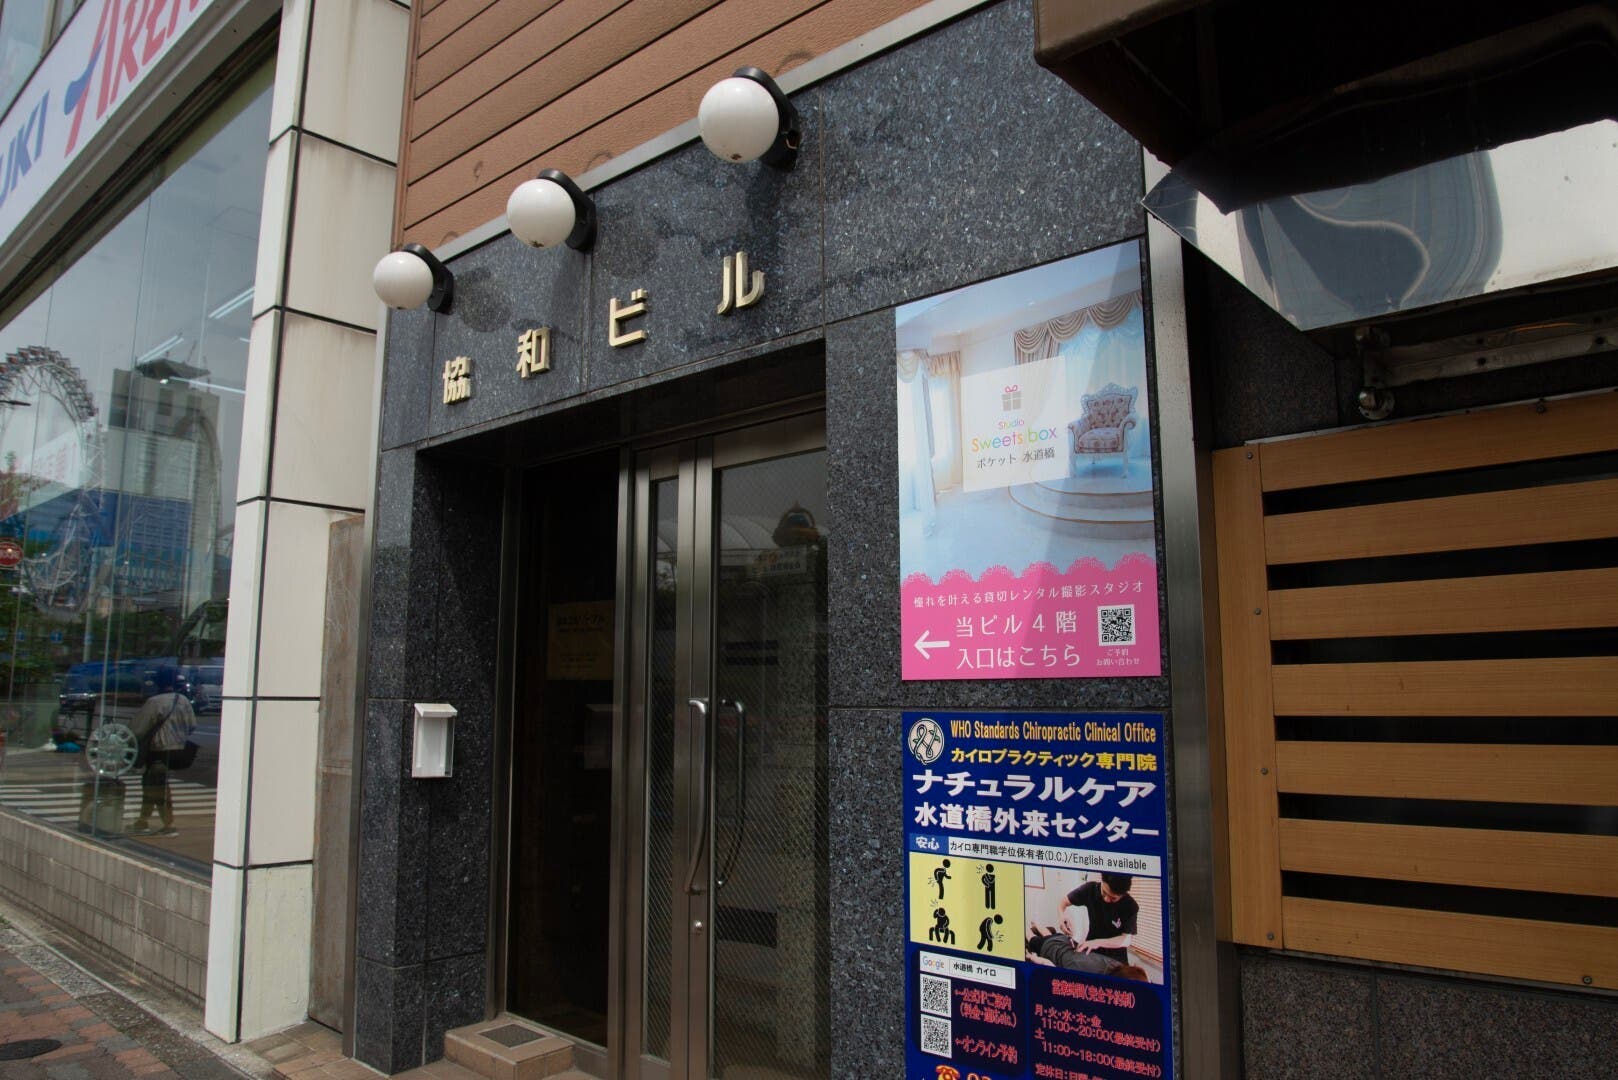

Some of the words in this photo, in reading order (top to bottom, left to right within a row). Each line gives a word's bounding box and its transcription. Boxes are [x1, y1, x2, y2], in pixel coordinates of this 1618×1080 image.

[64, 0, 200, 158] ARE
[443, 250, 766, 405] 協和ビル
[971, 431, 1023, 453] Sweets
[1028, 427, 1057, 442] box
[977, 453, 1017, 469] ポケット
[1022, 447, 1055, 463] 水道橋
[914, 580, 1145, 609] 憧れを叶える貸切レンタル撮影スタジオ
[956, 643, 1081, 670] 入口はこちら
[1096, 656, 1140, 666] お問い合わせ
[951, 720, 972, 738] WHO
[974, 721, 1020, 740] Standards
[1023, 721, 1081, 743] Chiropractic
[1084, 722, 1121, 742] Clinical
[1124, 722, 1156, 743] Office
[951, 747, 1157, 771] カイロプラクティック専門院
[912, 769, 1157, 808] ナチュラルケア
[914, 801, 1159, 843] 水道橋外来センター
[915, 836, 940, 851] 安心
[1107, 856, 1147, 870] available
[922, 955, 945, 971] Google
[953, 961, 974, 974] 水道橋
[976, 966, 997, 977] カイロ
[1034, 1027, 1045, 1040] 土
